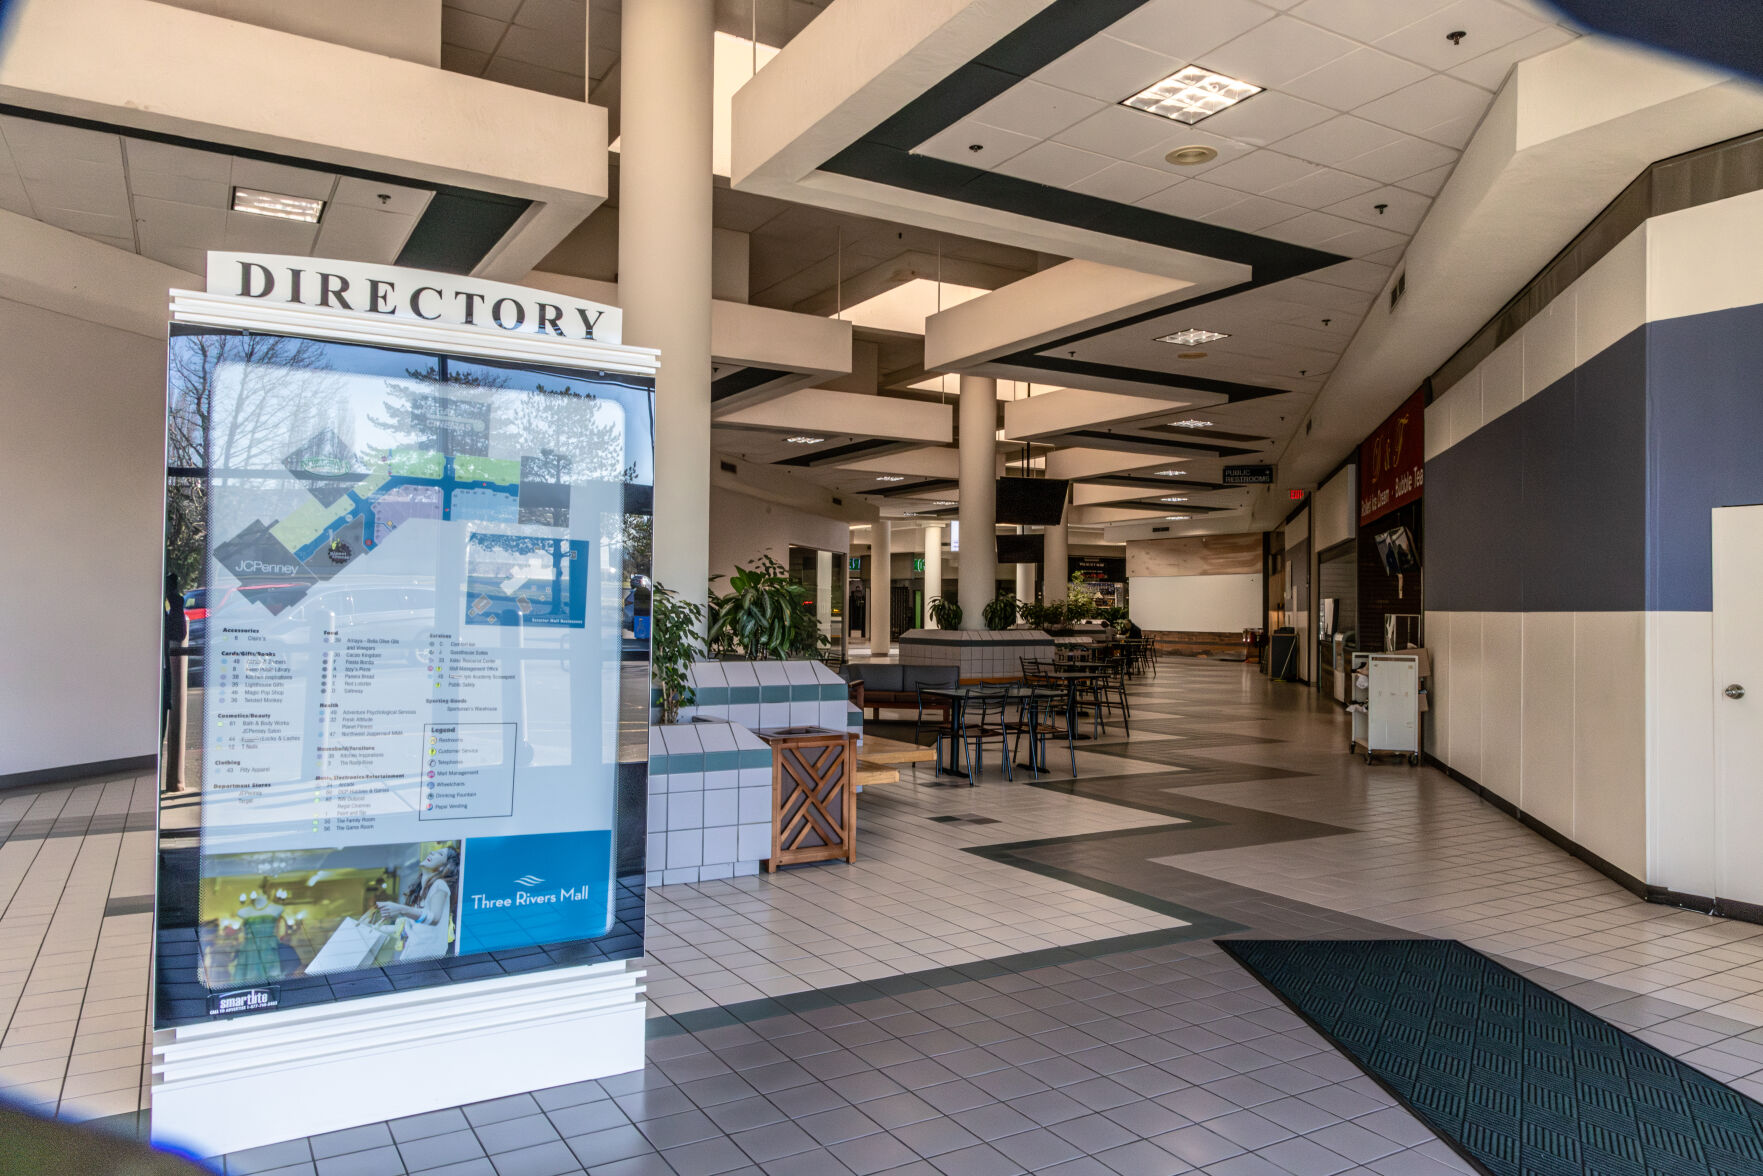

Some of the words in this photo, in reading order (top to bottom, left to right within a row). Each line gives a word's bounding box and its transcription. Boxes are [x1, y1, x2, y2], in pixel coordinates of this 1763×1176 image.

[237, 260, 604, 341] DIRECTORY
[1395, 471, 1413, 498] Bubble
[1413, 466, 1424, 488] Tea
[1290, 489, 1302, 500] EXIT
[235, 560, 299, 576] JCPenney
[471, 894, 512, 910] Three
[516, 891, 557, 906] Rivers
[560, 884, 589, 902] Mall
[220, 989, 268, 1009] smartlite
